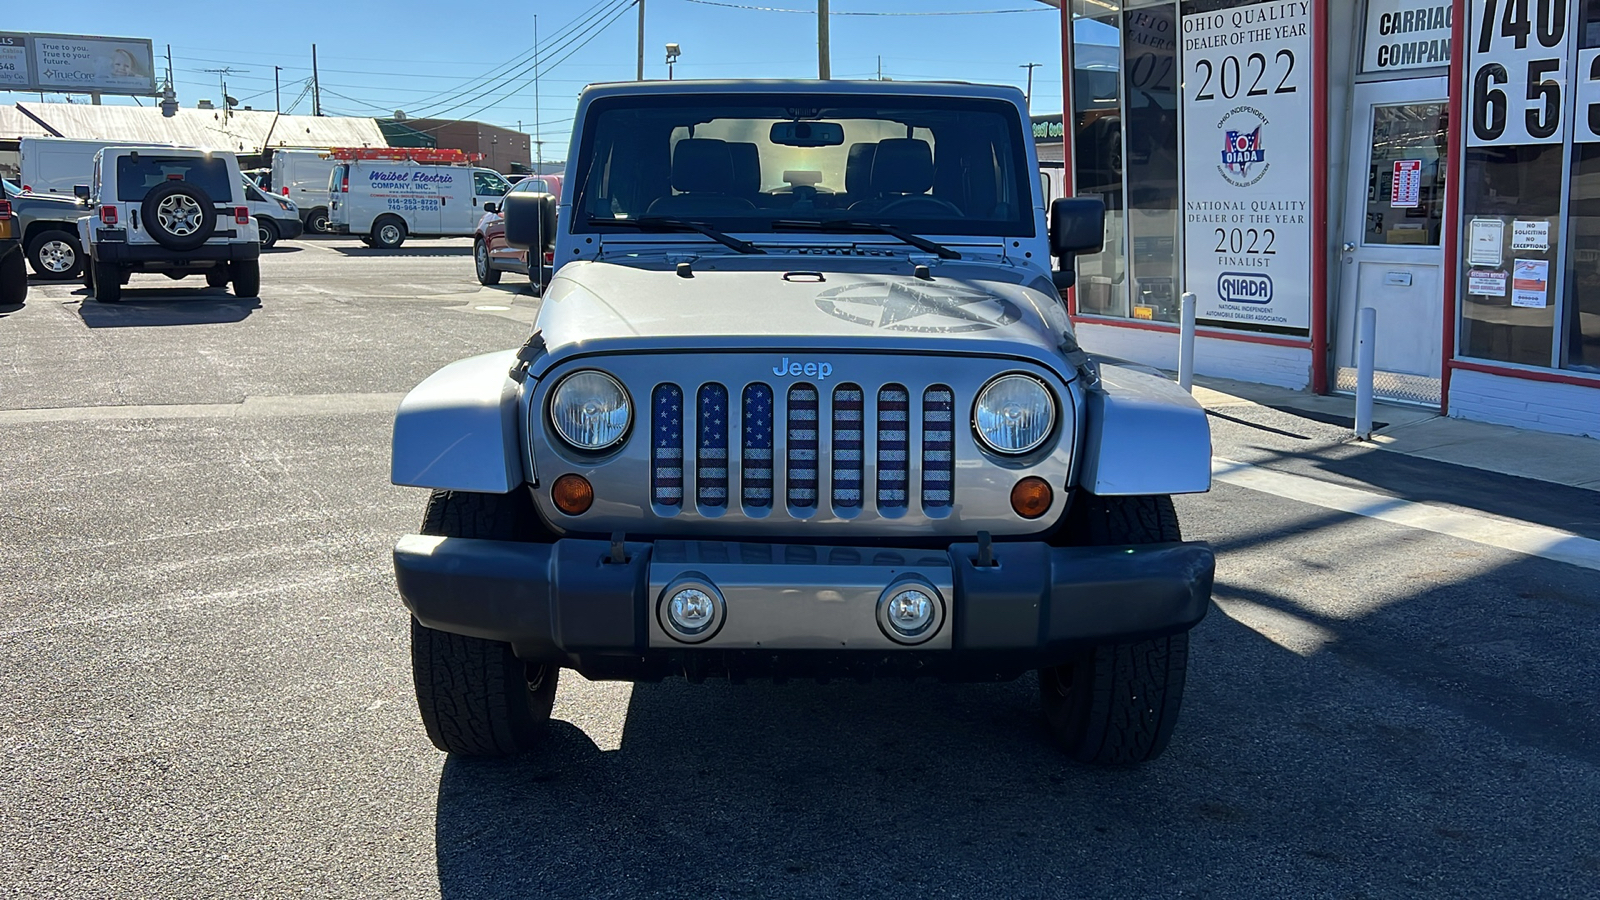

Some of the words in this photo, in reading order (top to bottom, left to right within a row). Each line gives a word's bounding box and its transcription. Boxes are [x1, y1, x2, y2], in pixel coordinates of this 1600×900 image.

[1184, 14, 1224, 33] OHIO
[1232, 1, 1309, 28] QUALITY
[1186, 34, 1228, 51] DEALER
[1230, 32, 1245, 45] OF
[1248, 27, 1271, 42] THE
[1274, 22, 1307, 39] YEAR
[44, 58, 71, 66] future.
[52, 70, 95, 80] TrueCore
[1195, 49, 1297, 101] 2022
[1217, 112, 1230, 129] OHIO
[1230, 105, 1270, 126] INDEPENDENT
[1226, 151, 1258, 163] OIADA
[369, 170, 409, 182] Waibel
[411, 171, 453, 184] Electric
[371, 182, 412, 191] COMPANY,
[387, 198, 438, 206] 614-253-8729
[1187, 201, 1246, 211] NATIONAL
[1251, 201, 1306, 212] QUALITY
[388, 204, 439, 212] 740-964-2956
[1188, 214, 1227, 223] DEALER
[1231, 214, 1245, 223] OF
[1249, 214, 1270, 224] THE
[1275, 215, 1304, 224] YEAR
[1214, 228, 1277, 255] 2022
[1218, 256, 1271, 267] FINALIST
[1222, 279, 1267, 300] NIADA
[1255, 315, 1287, 323] ASSOCIATION
[773, 357, 833, 380] Jeep
